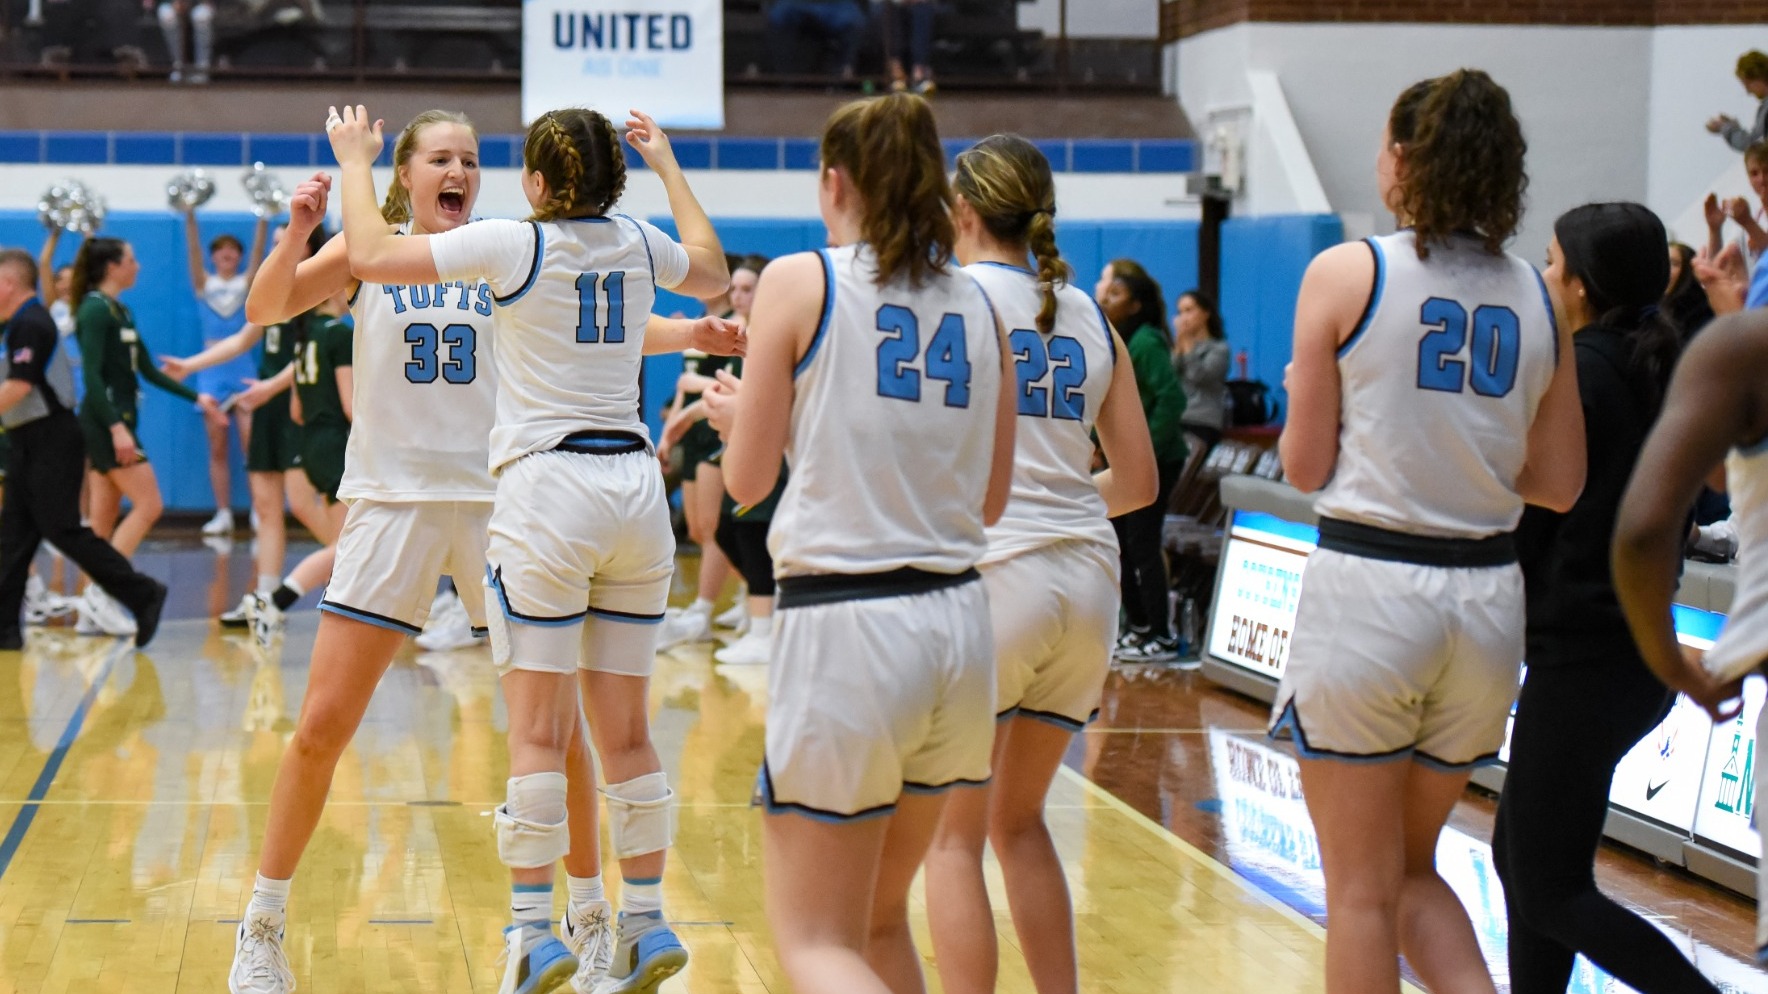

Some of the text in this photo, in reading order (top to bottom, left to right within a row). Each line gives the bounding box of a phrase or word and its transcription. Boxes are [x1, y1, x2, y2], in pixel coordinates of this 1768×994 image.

[553, 13, 691, 50] UNITED
[383, 281, 492, 317] TUFTS
[575, 271, 625, 343] 11
[404, 322, 477, 384] 33
[876, 303, 971, 409] 24
[1009, 328, 1087, 421] 22
[1417, 296, 1521, 398] 20
[1227, 615, 1288, 669] HOME OF
